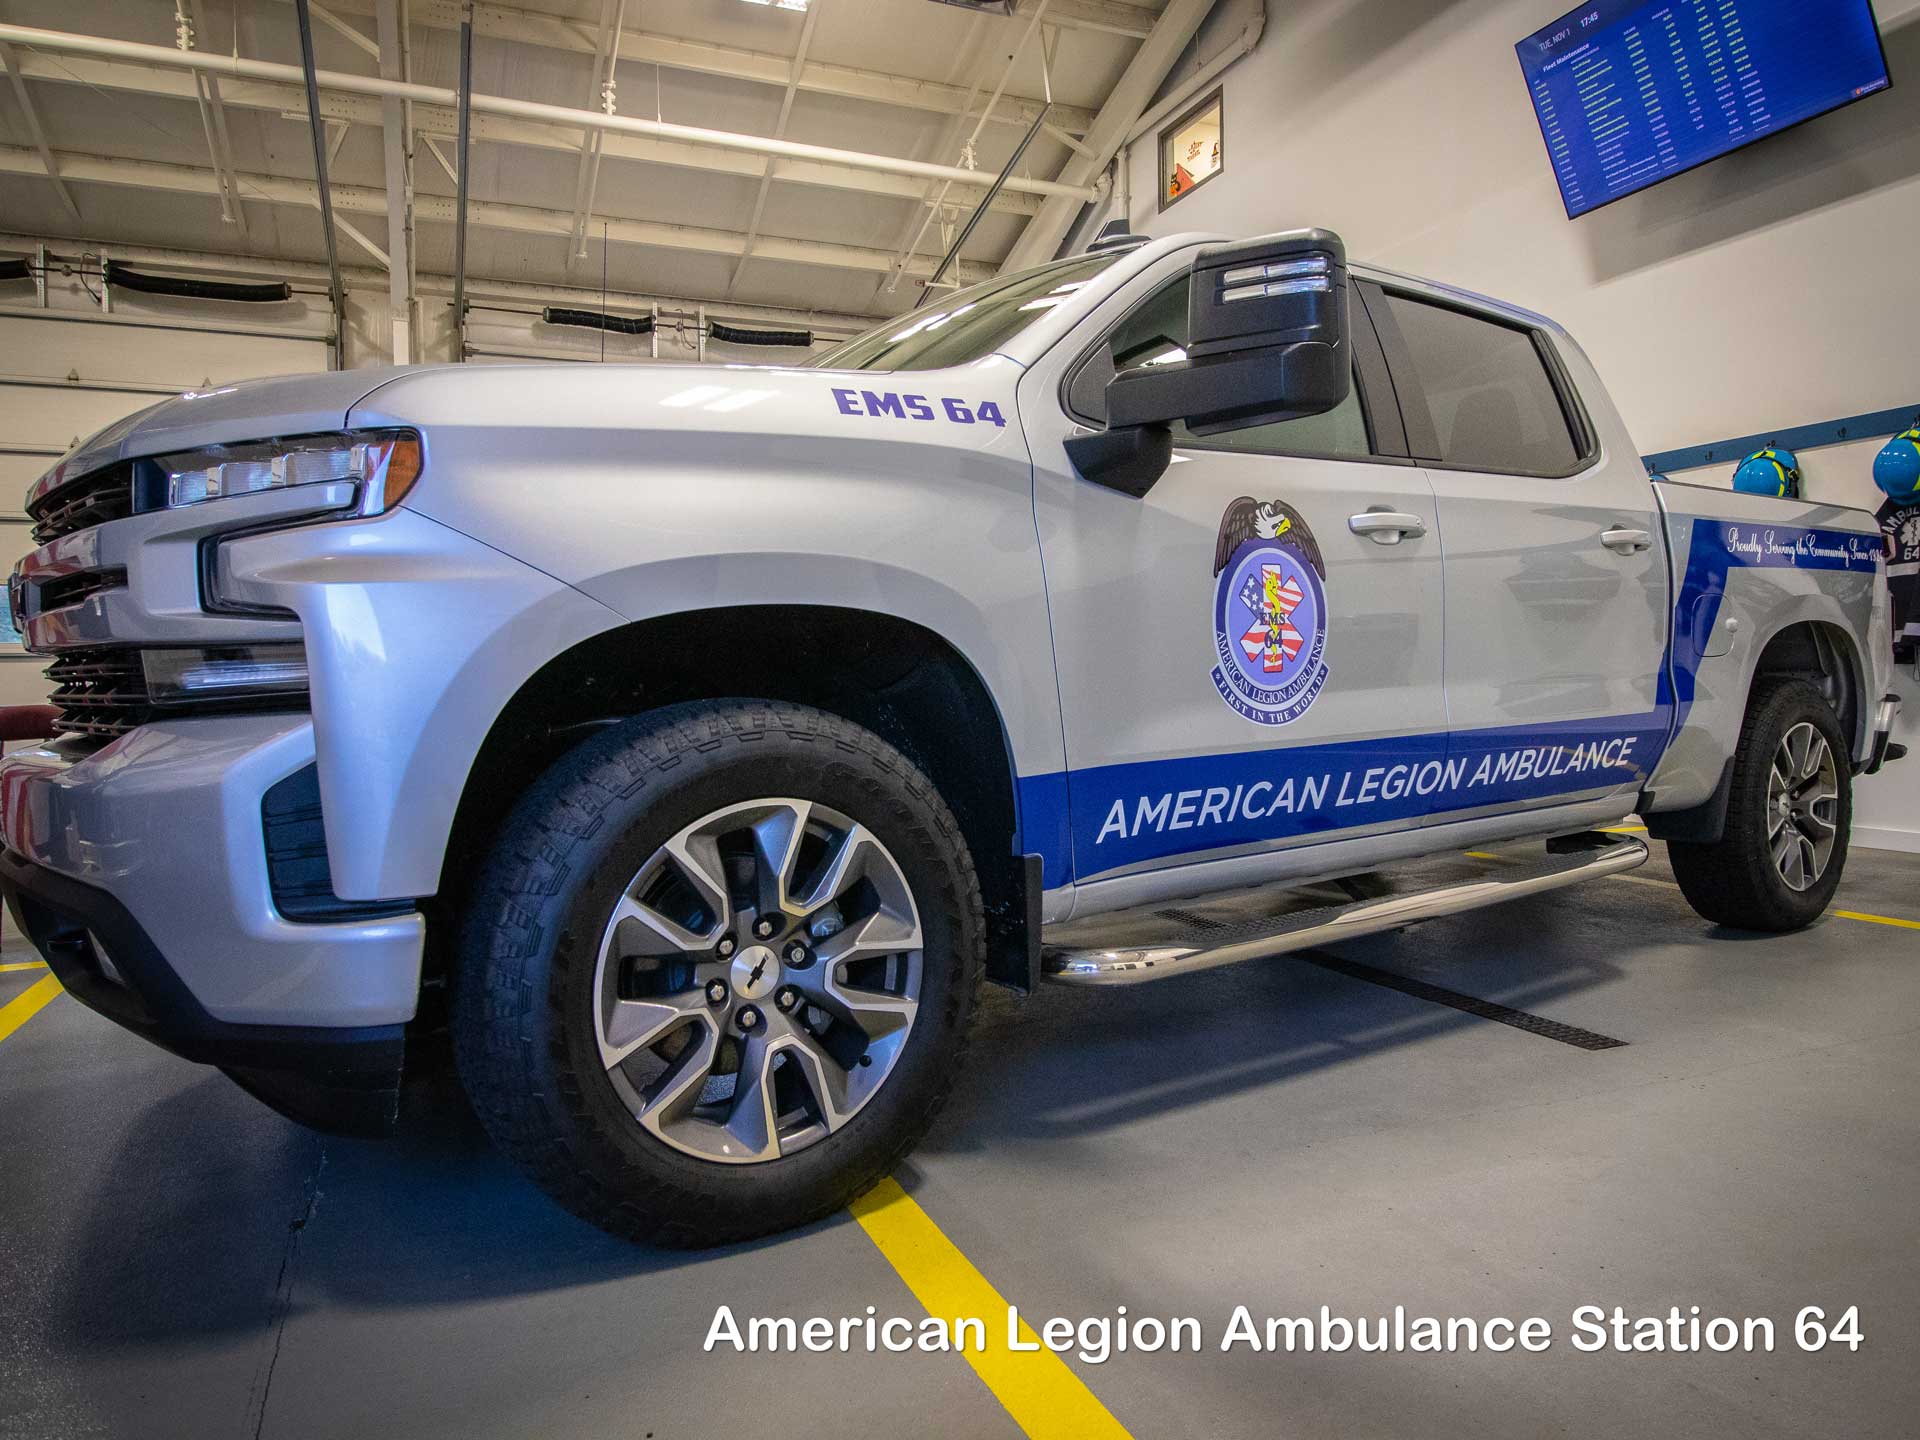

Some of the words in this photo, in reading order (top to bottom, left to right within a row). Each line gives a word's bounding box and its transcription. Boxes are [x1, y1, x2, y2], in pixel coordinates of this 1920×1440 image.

[1580, 11, 1599, 28] 17:45
[1552, 29, 1566, 44] NOV
[1542, 61, 1557, 73] Fleet
[1556, 43, 1590, 65] Maintenance
[831, 388, 936, 421] EMS
[941, 398, 1008, 428] 64
[1727, 527, 1762, 563] Proudly
[1764, 530, 1796, 565] Serving
[1795, 538, 1809, 556] the
[1805, 534, 1849, 568] Community
[1849, 537, 1869, 561] Since
[1903, 547, 1920, 562] 64
[1259, 612, 1286, 626] EMS
[1264, 629, 1284, 649] 64
[1217, 631, 1250, 695] AMERICAN
[1251, 690, 1288, 704] LEGION
[1287, 629, 1325, 697] AMBULANCE
[1218, 681, 1249, 715] FIRST
[1252, 709, 1265, 722] IN
[1268, 711, 1292, 723] THE
[1292, 676, 1323, 714] WORLD
[1095, 776, 1333, 845] AMERICAN
[1335, 757, 1468, 808] LEGION
[1466, 736, 1638, 789] AMBULANCE
